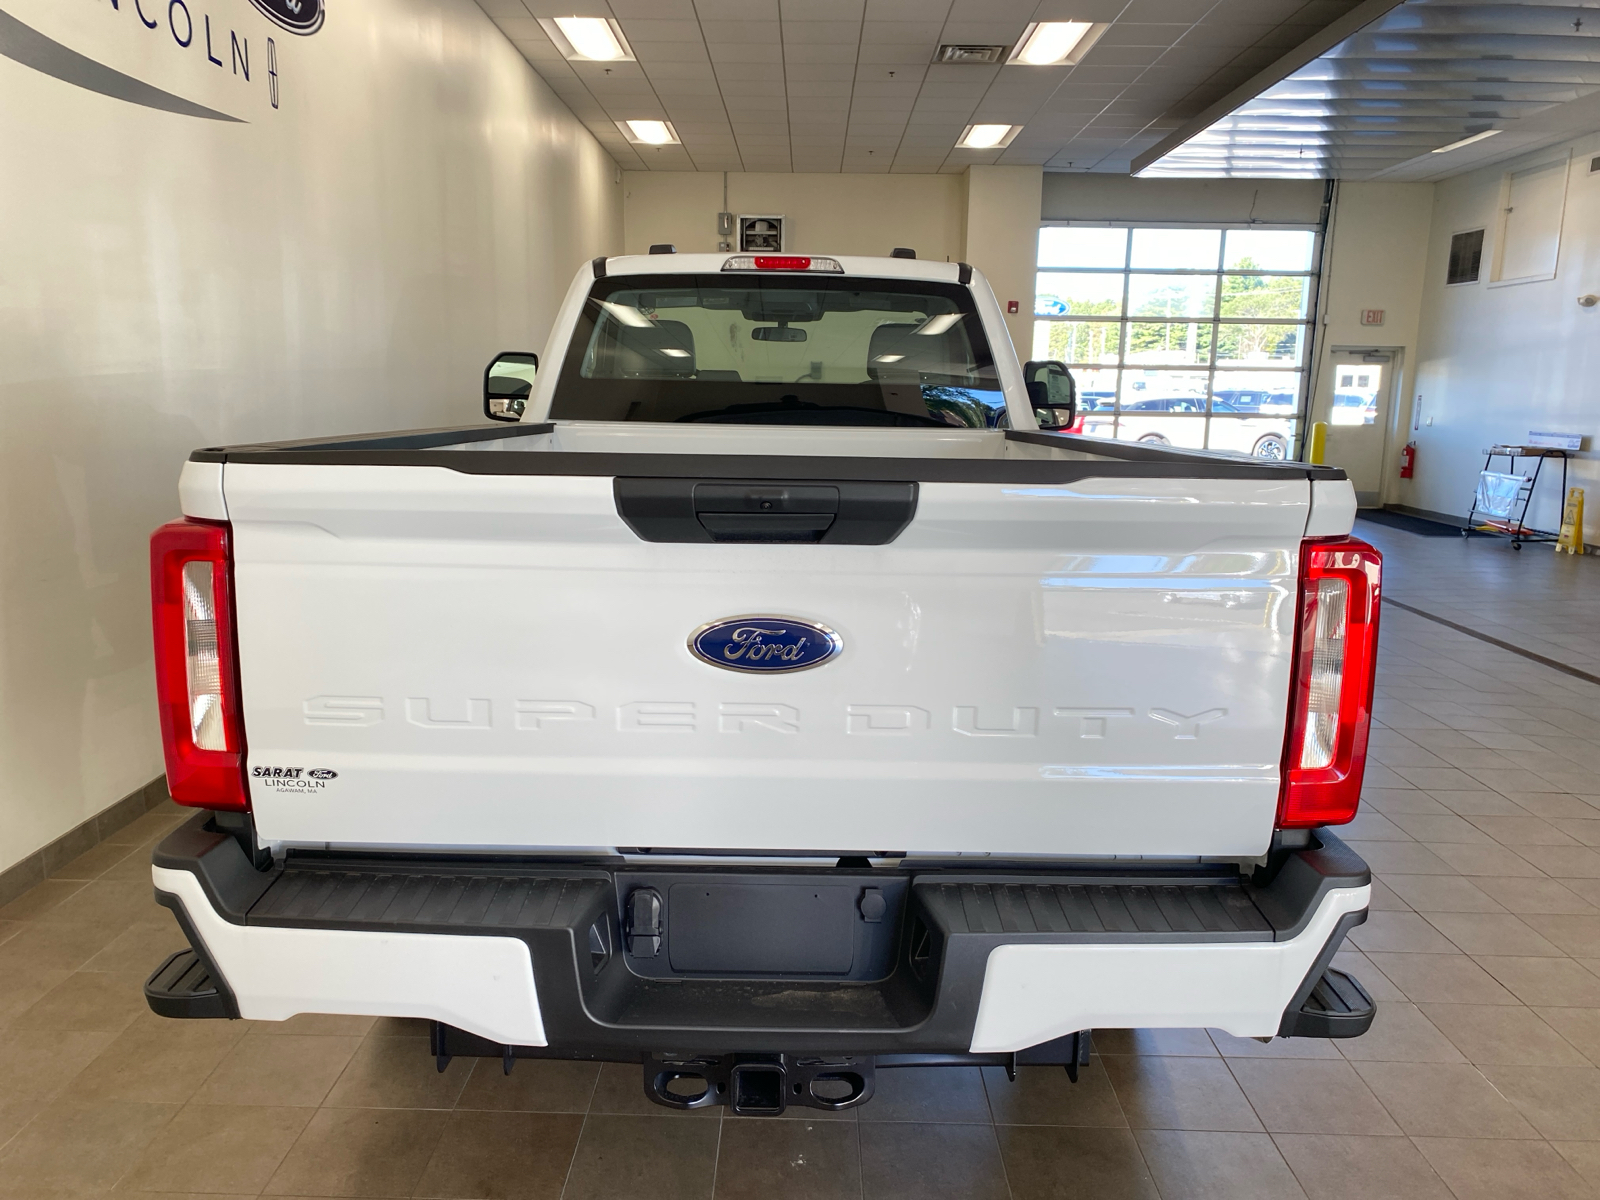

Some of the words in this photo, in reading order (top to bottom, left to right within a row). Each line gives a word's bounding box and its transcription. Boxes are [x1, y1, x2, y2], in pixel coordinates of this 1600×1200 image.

[1366, 310, 1384, 323] EXIT
[723, 627, 807, 661] Ford
[303, 695, 800, 734] SUPER
[846, 704, 1228, 739] DUTY
[252, 767, 303, 778] SARAT
[311, 770, 334, 779] Ford
[264, 779, 325, 788] LINCOLN
